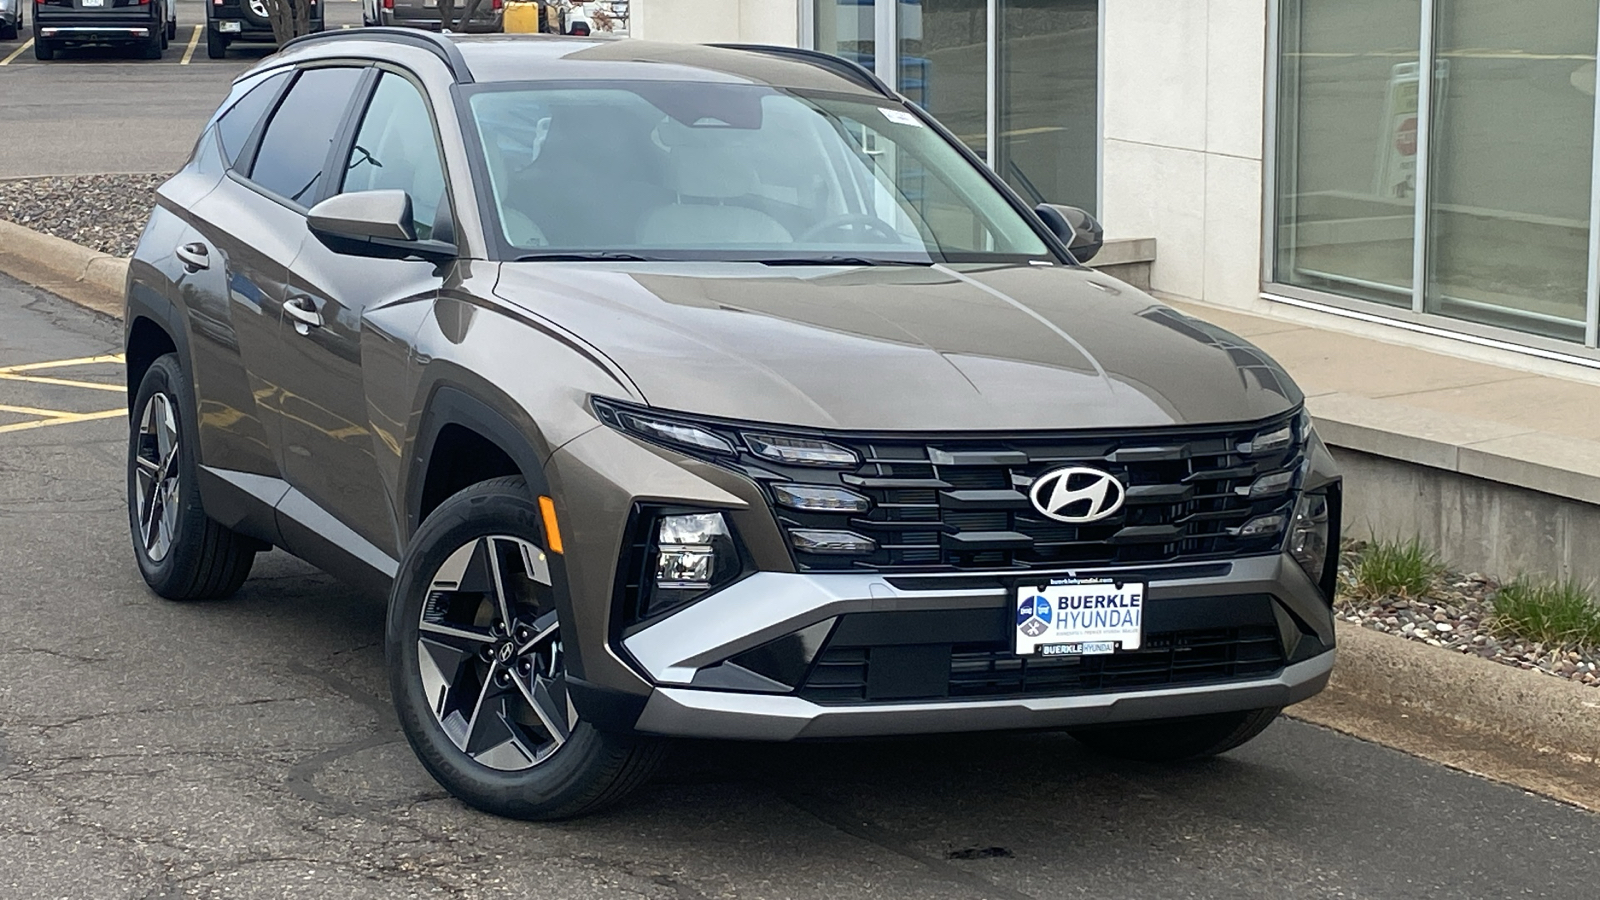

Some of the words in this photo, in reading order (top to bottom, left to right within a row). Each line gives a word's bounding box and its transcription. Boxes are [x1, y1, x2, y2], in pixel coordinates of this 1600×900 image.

[1058, 594, 1141, 610] BUERKLE
[1056, 609, 1139, 629] HYUNDAI
[1043, 645, 1082, 655] BUERKLE
[1084, 642, 1113, 652] HYUNDAI
